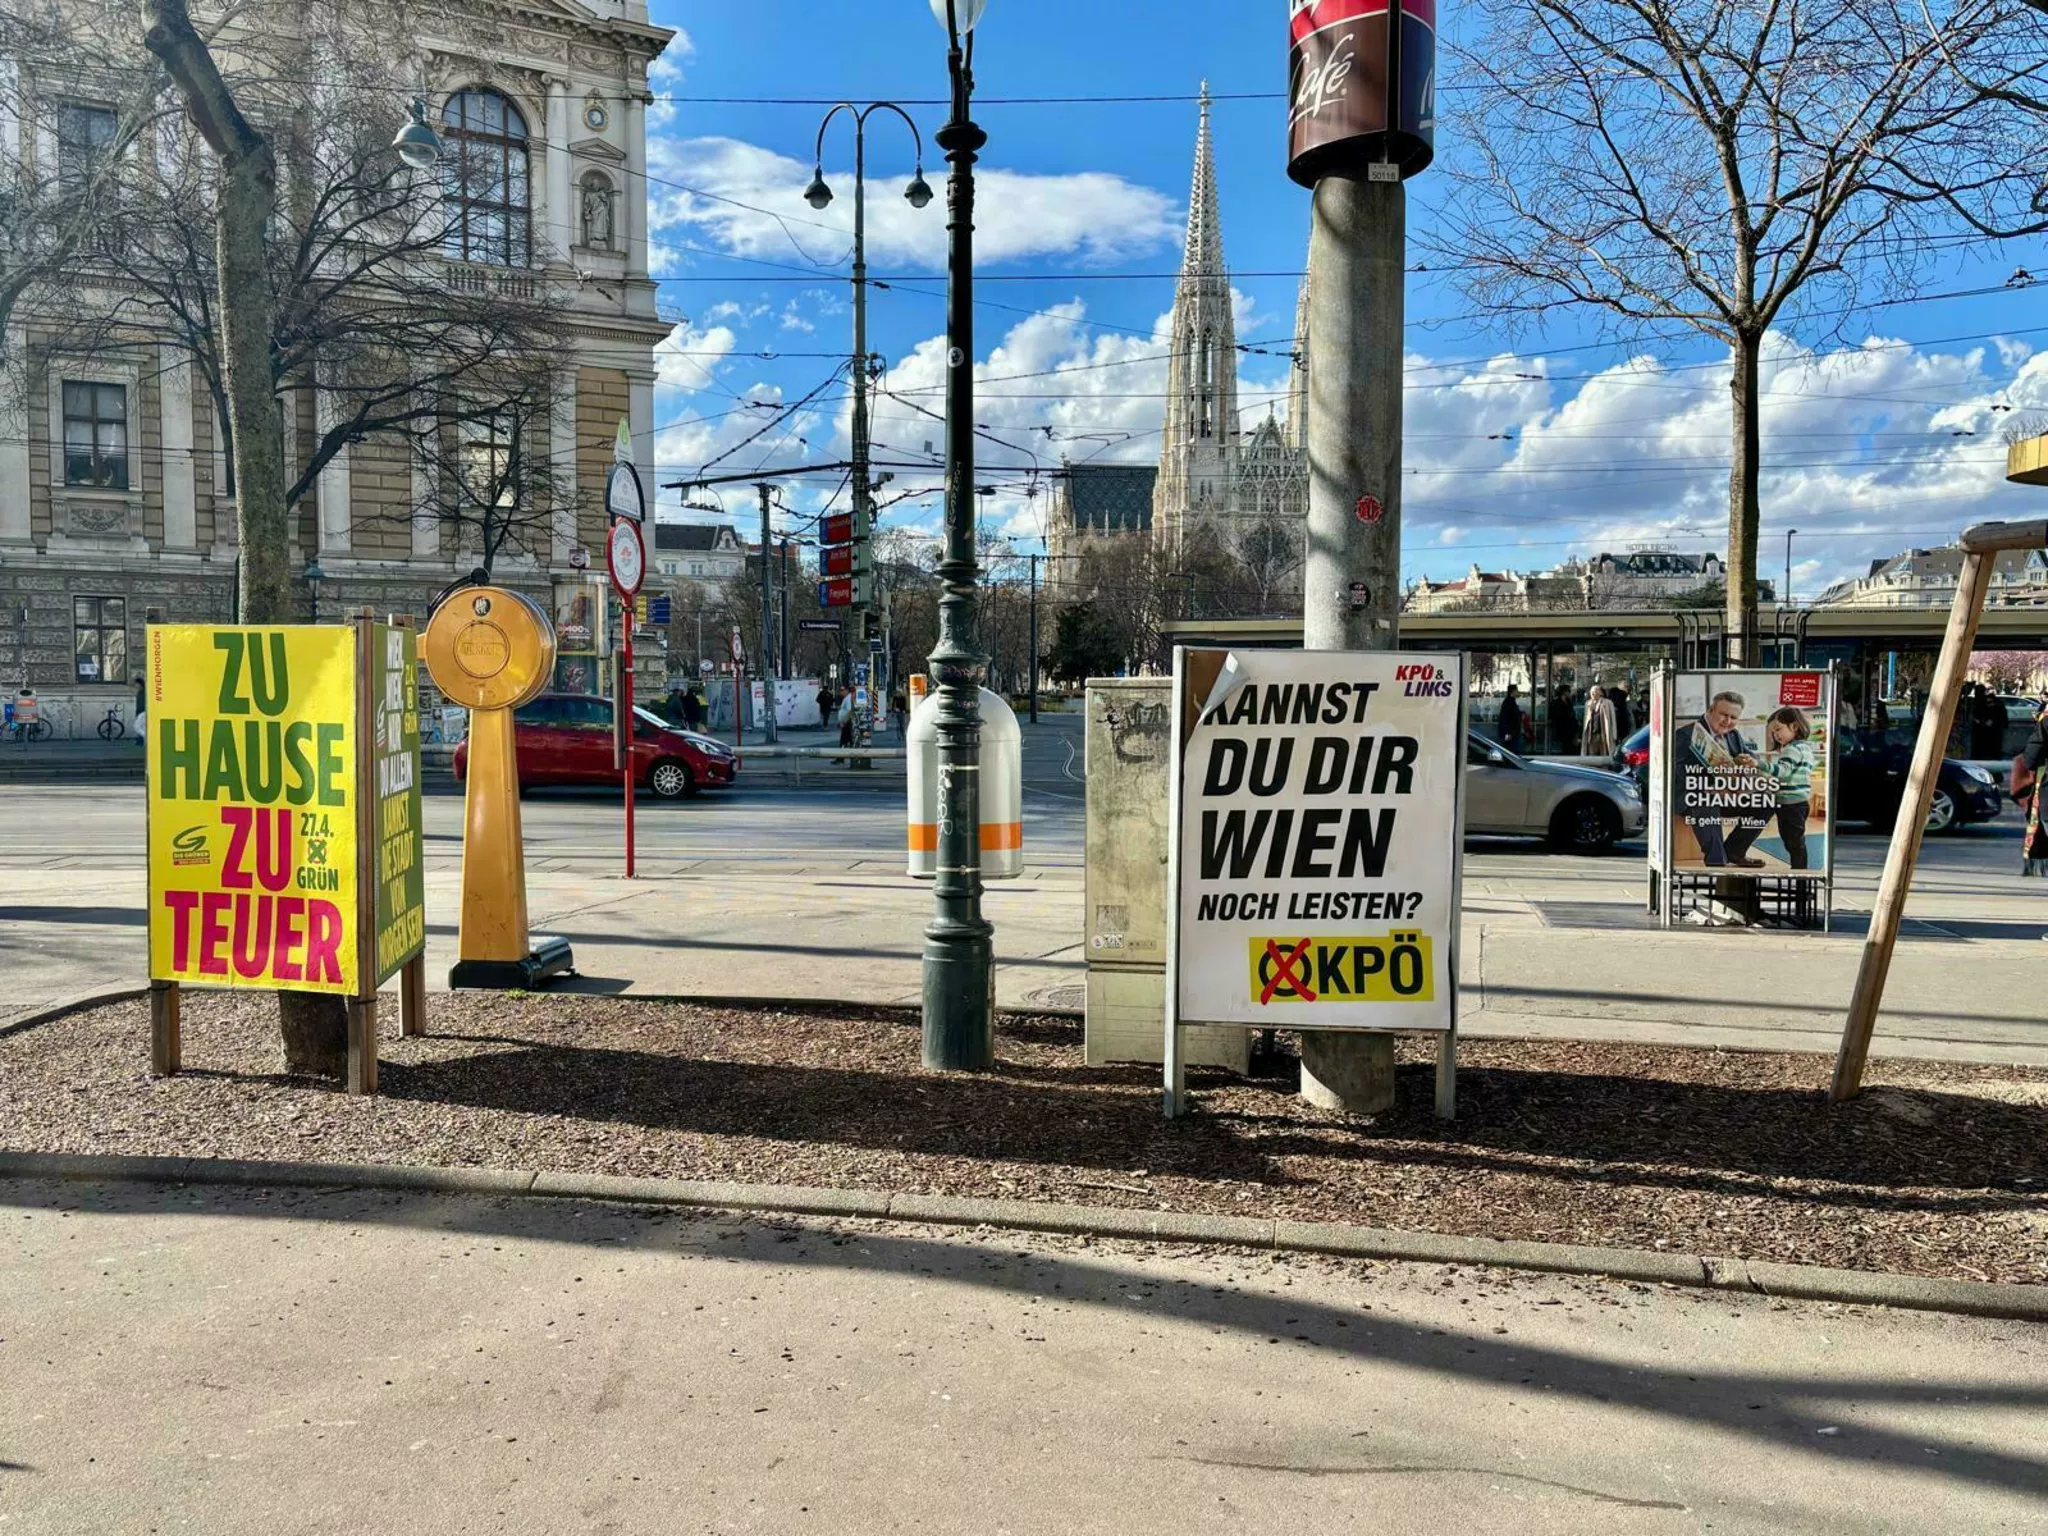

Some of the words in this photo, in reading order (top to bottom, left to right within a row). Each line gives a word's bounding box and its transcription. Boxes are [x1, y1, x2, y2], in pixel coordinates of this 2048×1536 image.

[153, 631, 163, 702] #WIENMORGEN
[213, 632, 289, 717] ZU
[1395, 663, 1434, 681] KPÖ
[1435, 669, 1445, 680] &
[1404, 681, 1452, 697] LINKS
[160, 718, 345, 806] HAUSE
[389, 750, 413, 794] ALLEIN
[1203, 738, 1294, 796] DU
[1303, 736, 1418, 795] DIR
[1685, 764, 1704, 774] Wir
[1707, 764, 1758, 775] schaffen
[1685, 776, 1788, 792] BILDUNGS-
[383, 790, 410, 840] KANNST
[1685, 793, 1782, 808] CHANCEN.
[1685, 816, 1697, 825] Es
[1698, 815, 1721, 828] geht
[1723, 818, 1739, 826] um
[300, 812, 335, 838] 27.4.
[1200, 808, 1396, 880] WIEN
[221, 806, 292, 891] ZU
[392, 829, 415, 877] STADT
[296, 866, 339, 892] GRÜN
[389, 874, 407, 919] VON
[1197, 893, 1279, 921] NOCH
[1288, 892, 1423, 921] LEISTEN?
[165, 890, 343, 985] TEUER
[378, 913, 408, 976] MORGEN
[407, 903, 424, 949] SEIN
[1318, 934, 1424, 995] KPÖ
